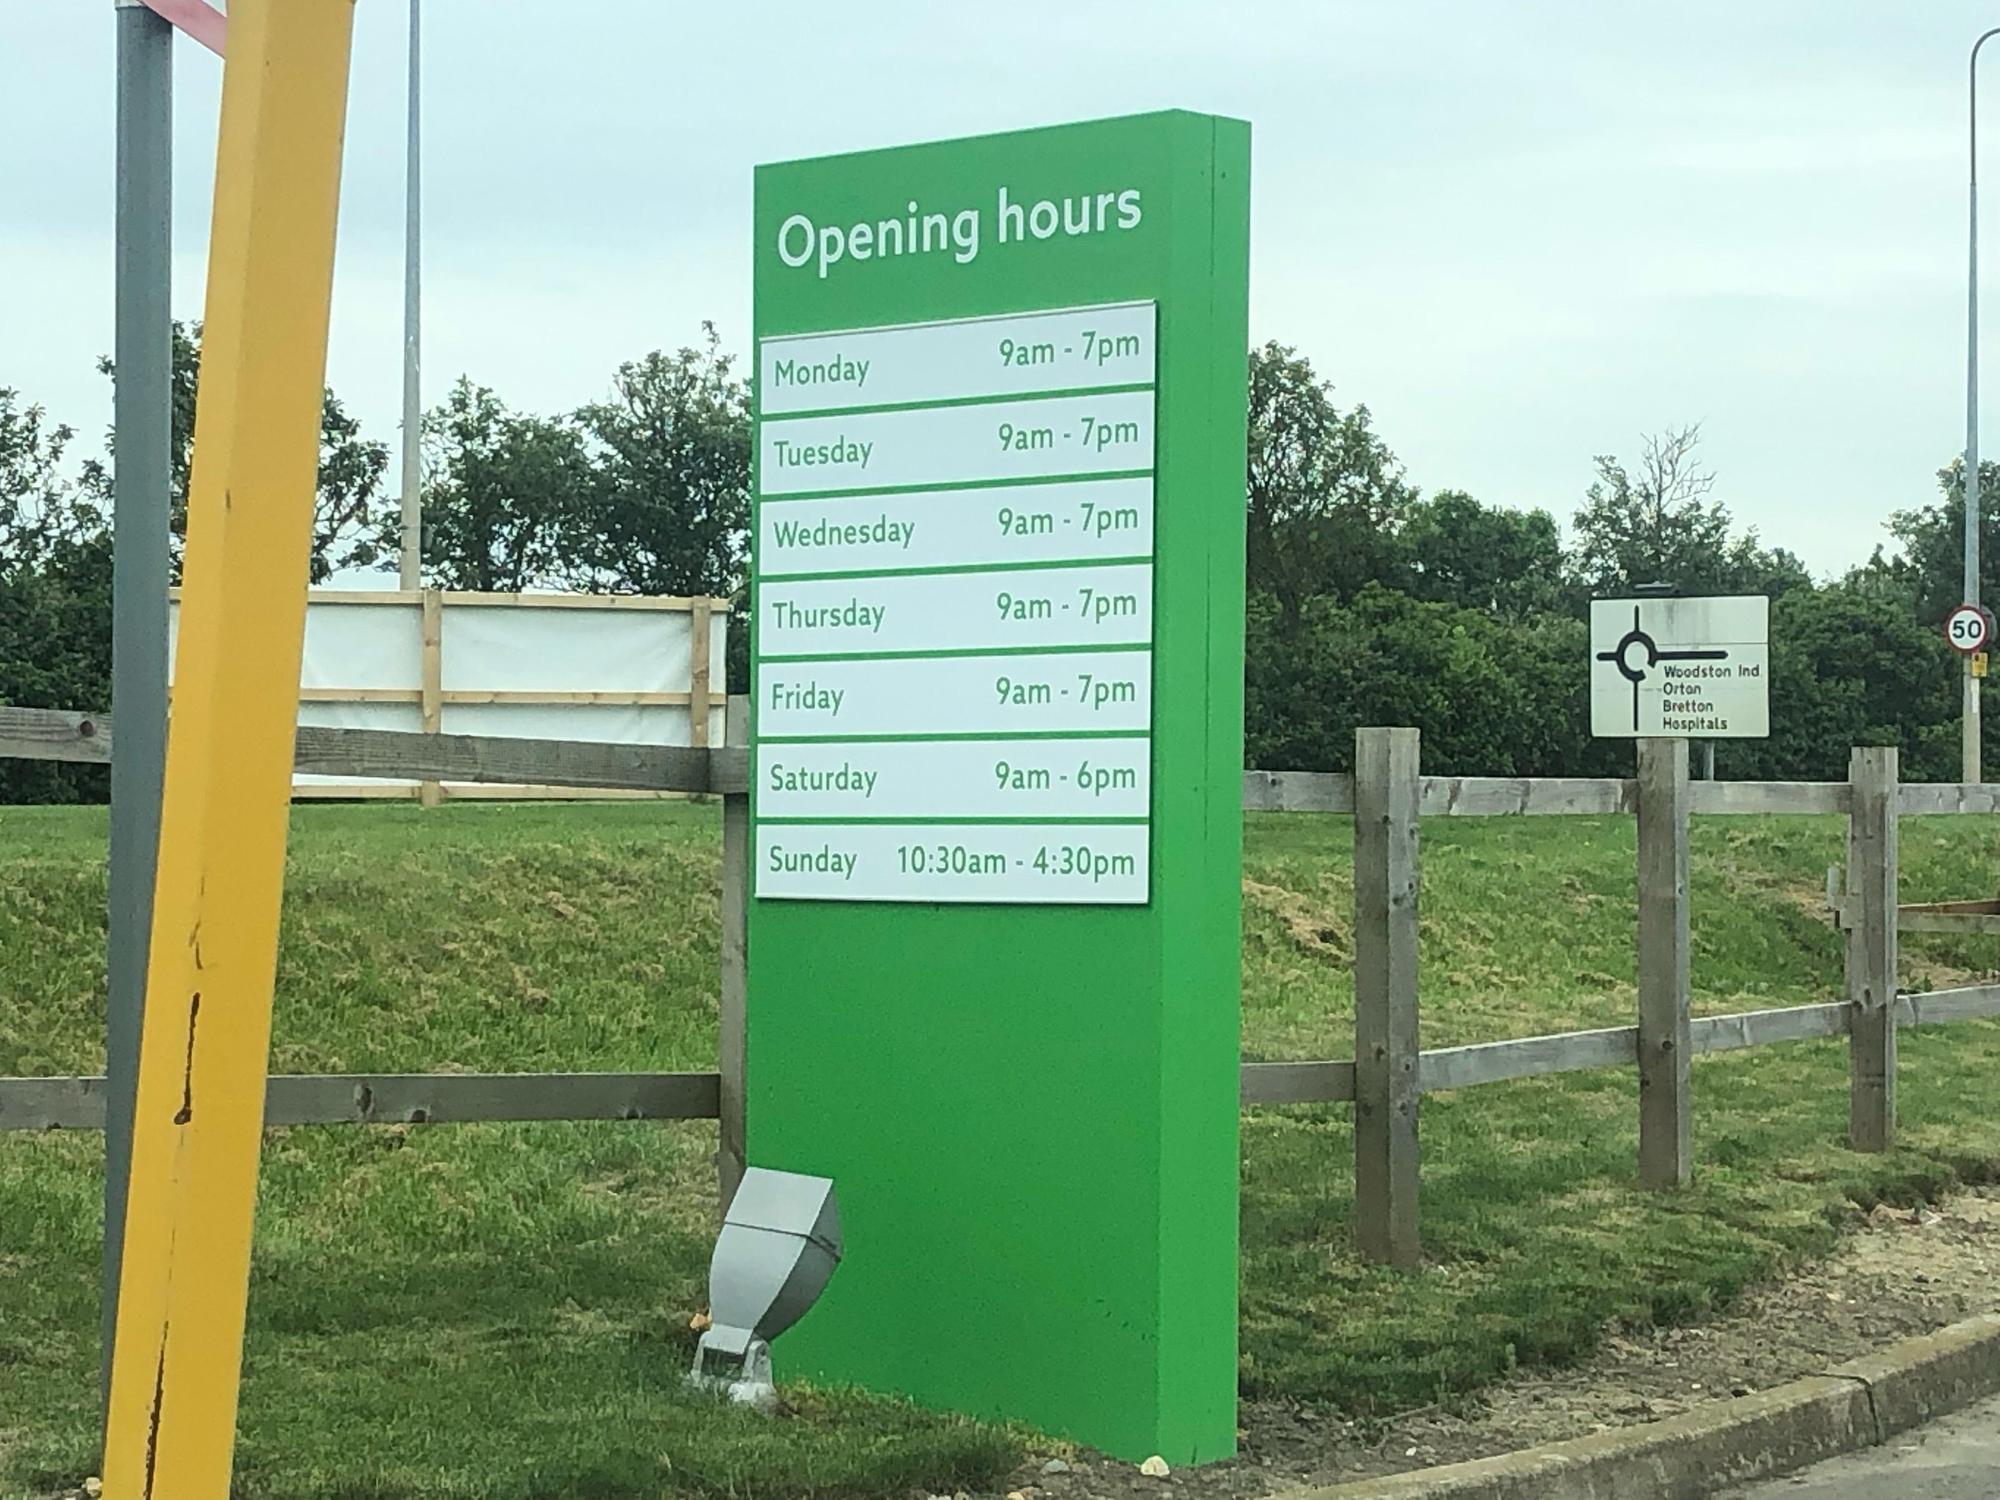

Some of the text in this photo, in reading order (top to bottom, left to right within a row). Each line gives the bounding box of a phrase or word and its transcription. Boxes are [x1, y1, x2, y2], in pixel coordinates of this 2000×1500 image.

[778, 187, 1142, 278] Opening hours
[775, 354, 870, 387] Monday
[1000, 339, 1055, 366] 9am
[1082, 331, 1140, 366] 7pm
[773, 435, 873, 468] Tuesday
[999, 423, 1053, 451] 9am
[1081, 417, 1139, 453] 7pm
[773, 514, 915, 549] Wednesday
[998, 507, 1054, 536] 9am
[1080, 502, 1139, 538] 7pm
[772, 597, 886, 633] Thursday
[997, 592, 1052, 621] 9am
[1079, 588, 1137, 624] 7pm
[1952, 620, 1982, 639] 50
[1663, 682, 1701, 695] Orton
[1664, 664, 1760, 678] Woodston Ind
[772, 681, 845, 716] Friday
[996, 676, 1051, 705] 9am
[1078, 674, 1136, 711] 7pm
[1663, 700, 1713, 713] Bretton
[1663, 717, 1728, 732] Hospitals
[770, 762, 878, 798] Saturday
[995, 760, 1050, 790] 9am
[1077, 760, 1136, 797] 6pm
[769, 844, 857, 881] Sunday
[898, 845, 1007, 875] 10:30am
[1033, 846, 1135, 883] 4:30pm
